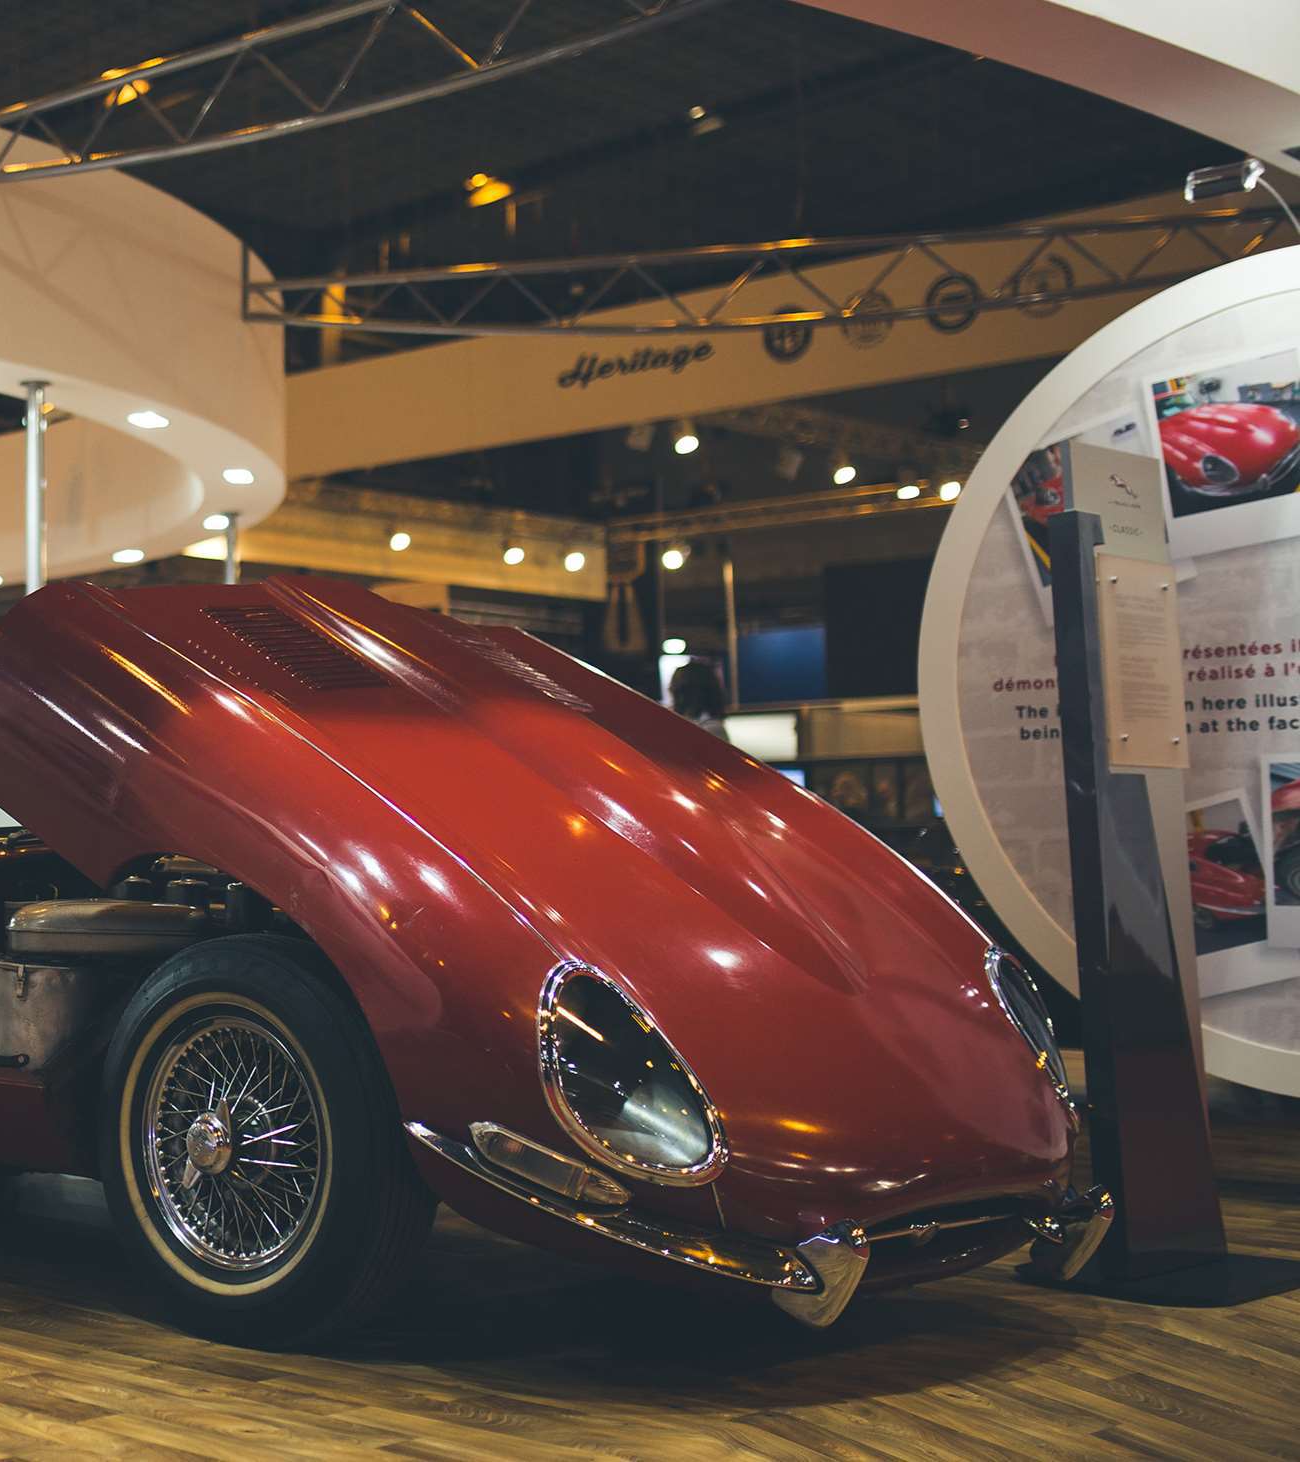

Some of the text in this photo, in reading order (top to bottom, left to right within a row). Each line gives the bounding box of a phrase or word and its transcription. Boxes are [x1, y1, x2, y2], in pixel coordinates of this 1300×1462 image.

[558, 340, 715, 388] Heritage
[993, 677, 1056, 693] démon
[1188, 663, 1255, 681] réalisé
[1264, 662, 1275, 678] à
[1015, 705, 1049, 719] The
[1202, 696, 1247, 711] here
[1020, 725, 1060, 740] bein
[1199, 720, 1219, 734] at
[1226, 717, 1260, 732] the
